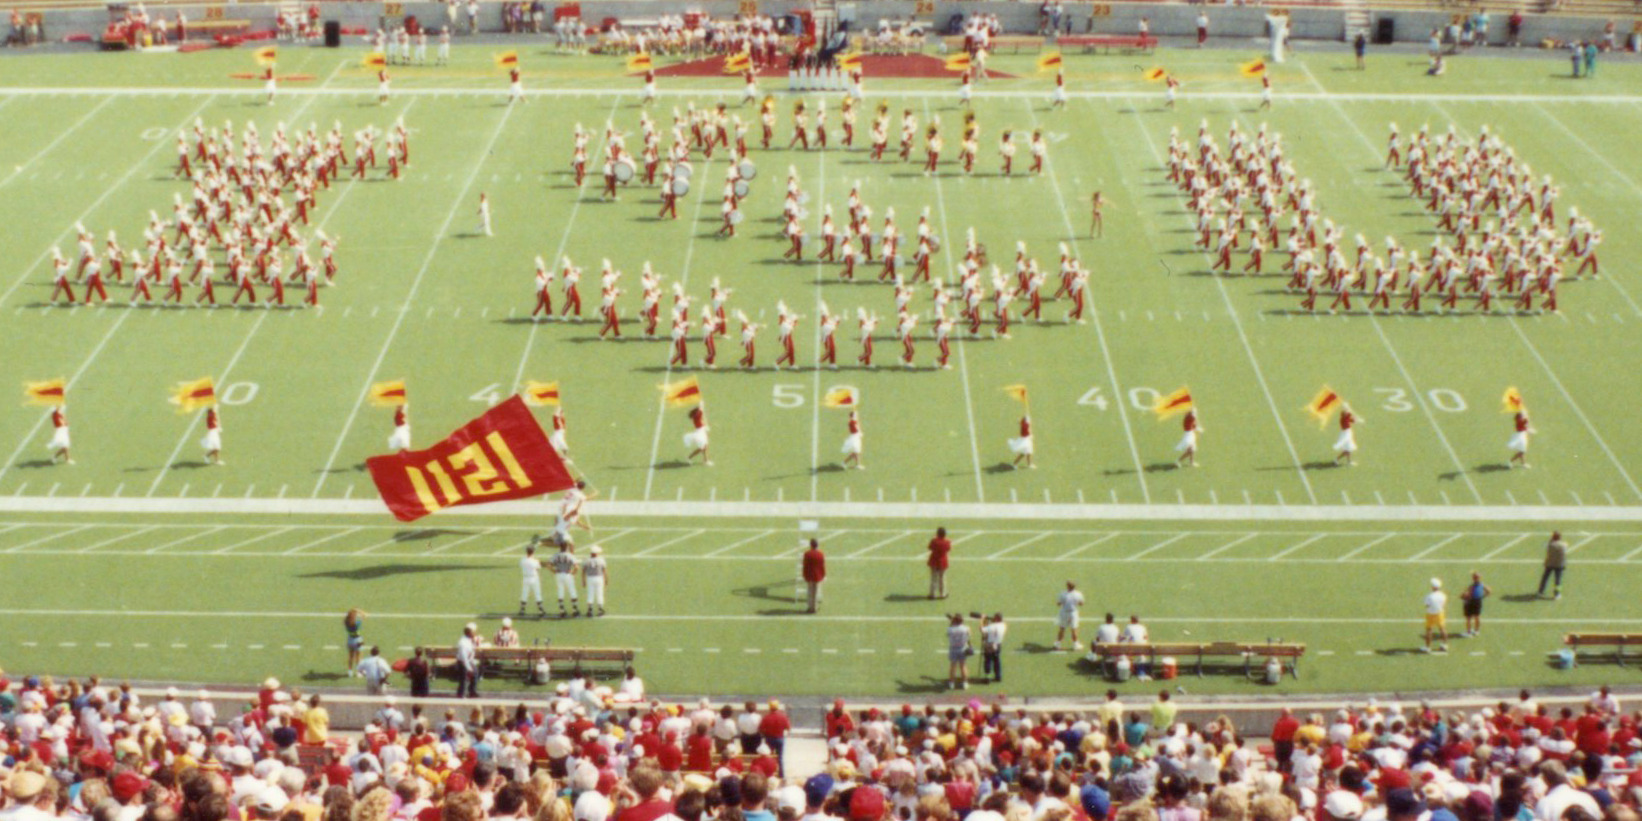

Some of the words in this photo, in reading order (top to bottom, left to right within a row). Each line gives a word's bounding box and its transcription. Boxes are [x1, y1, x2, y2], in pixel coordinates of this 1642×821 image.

[386, 3, 402, 14] 27
[916, 2, 933, 13] 24
[1094, 5, 1111, 16] 23
[772, 384, 860, 408] 50
[1077, 387, 1162, 410] 40
[1373, 388, 1468, 412] 30
